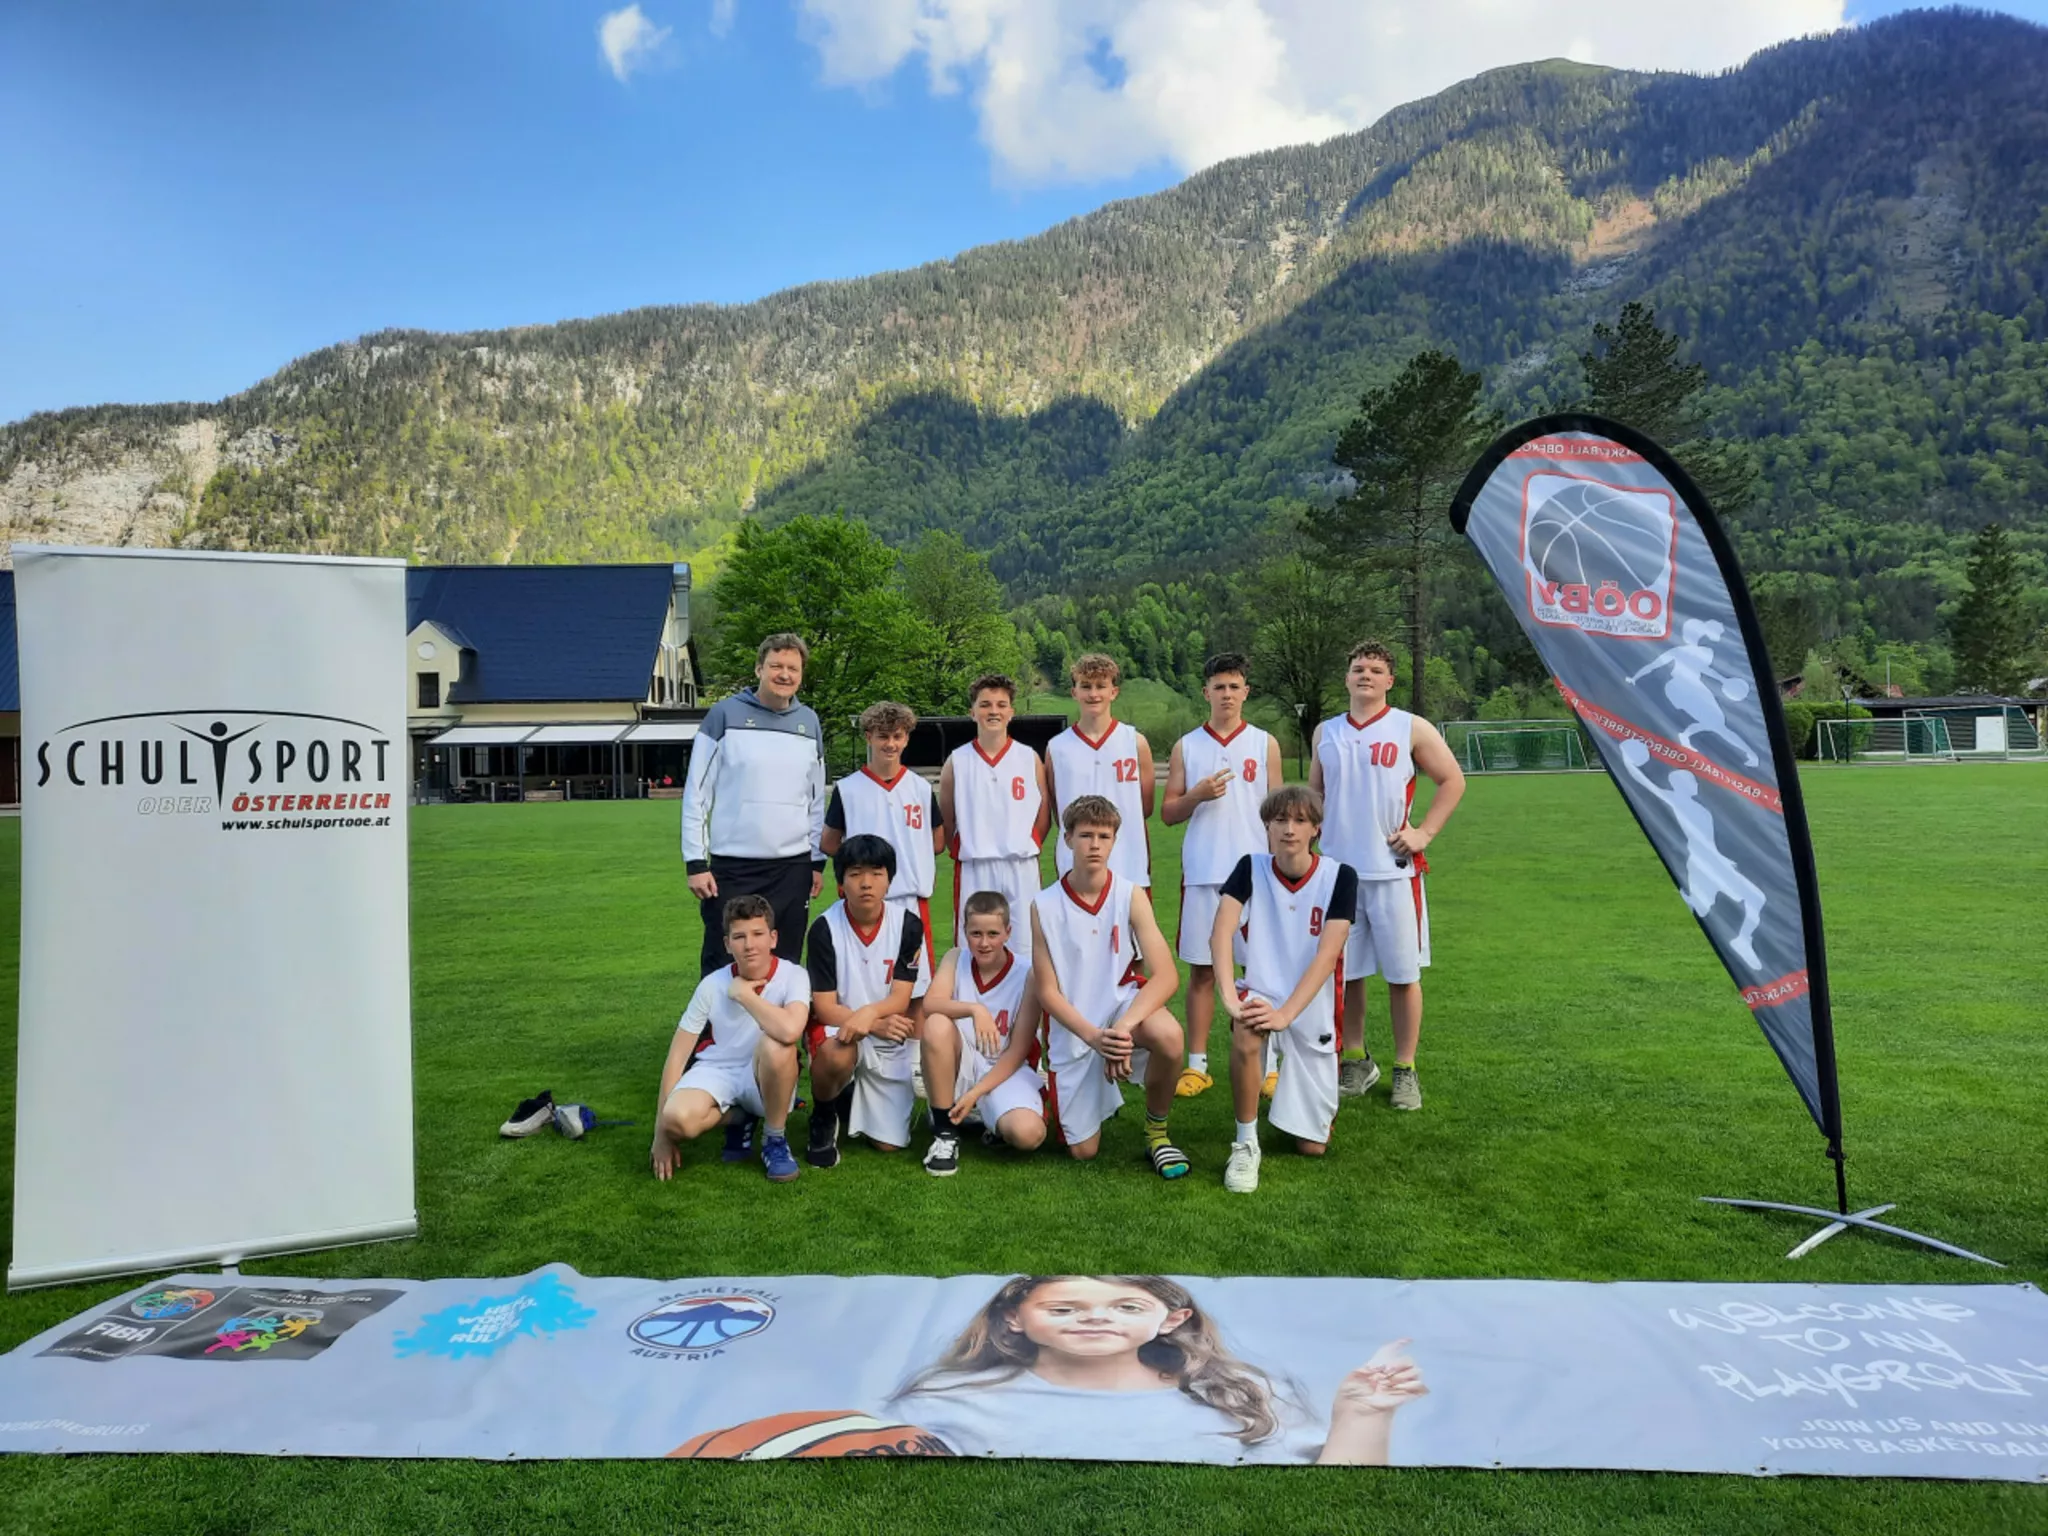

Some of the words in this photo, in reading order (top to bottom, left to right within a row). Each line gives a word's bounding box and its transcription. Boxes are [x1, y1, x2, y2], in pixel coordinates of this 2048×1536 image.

[36, 740, 198, 788] SCHUL
[248, 740, 391, 785] SPORT
[1369, 741, 1398, 768] 10
[1112, 758, 1138, 782] 12
[1242, 758, 1256, 783] 8
[1011, 776, 1026, 800] 6
[137, 796, 213, 815] OBER
[231, 792, 391, 813] ÖSTERREICH
[221, 816, 391, 831] www.schulsportooe.at
[903, 804, 922, 830] 13
[1309, 906, 1322, 937] 9
[883, 959, 894, 984] 7
[994, 1009, 1009, 1036] 4
[657, 1286, 783, 1304] BASKETBALL
[1668, 1297, 1977, 1335] WELCOME
[84, 1321, 156, 1343] FIBA
[629, 1347, 726, 1361] AUSTRIA
[1758, 1327, 1851, 1357] TO
[1858, 1328, 1967, 1363] MY
[1698, 1358, 2048, 1408] PLAYGROUN
[1800, 1418, 1873, 1436] JOIN
[1876, 1416, 1923, 1434] US
[1929, 1419, 1999, 1437] AND
[2002, 1420, 2048, 1438] LIV
[1760, 1436, 1850, 1453] YOUR
